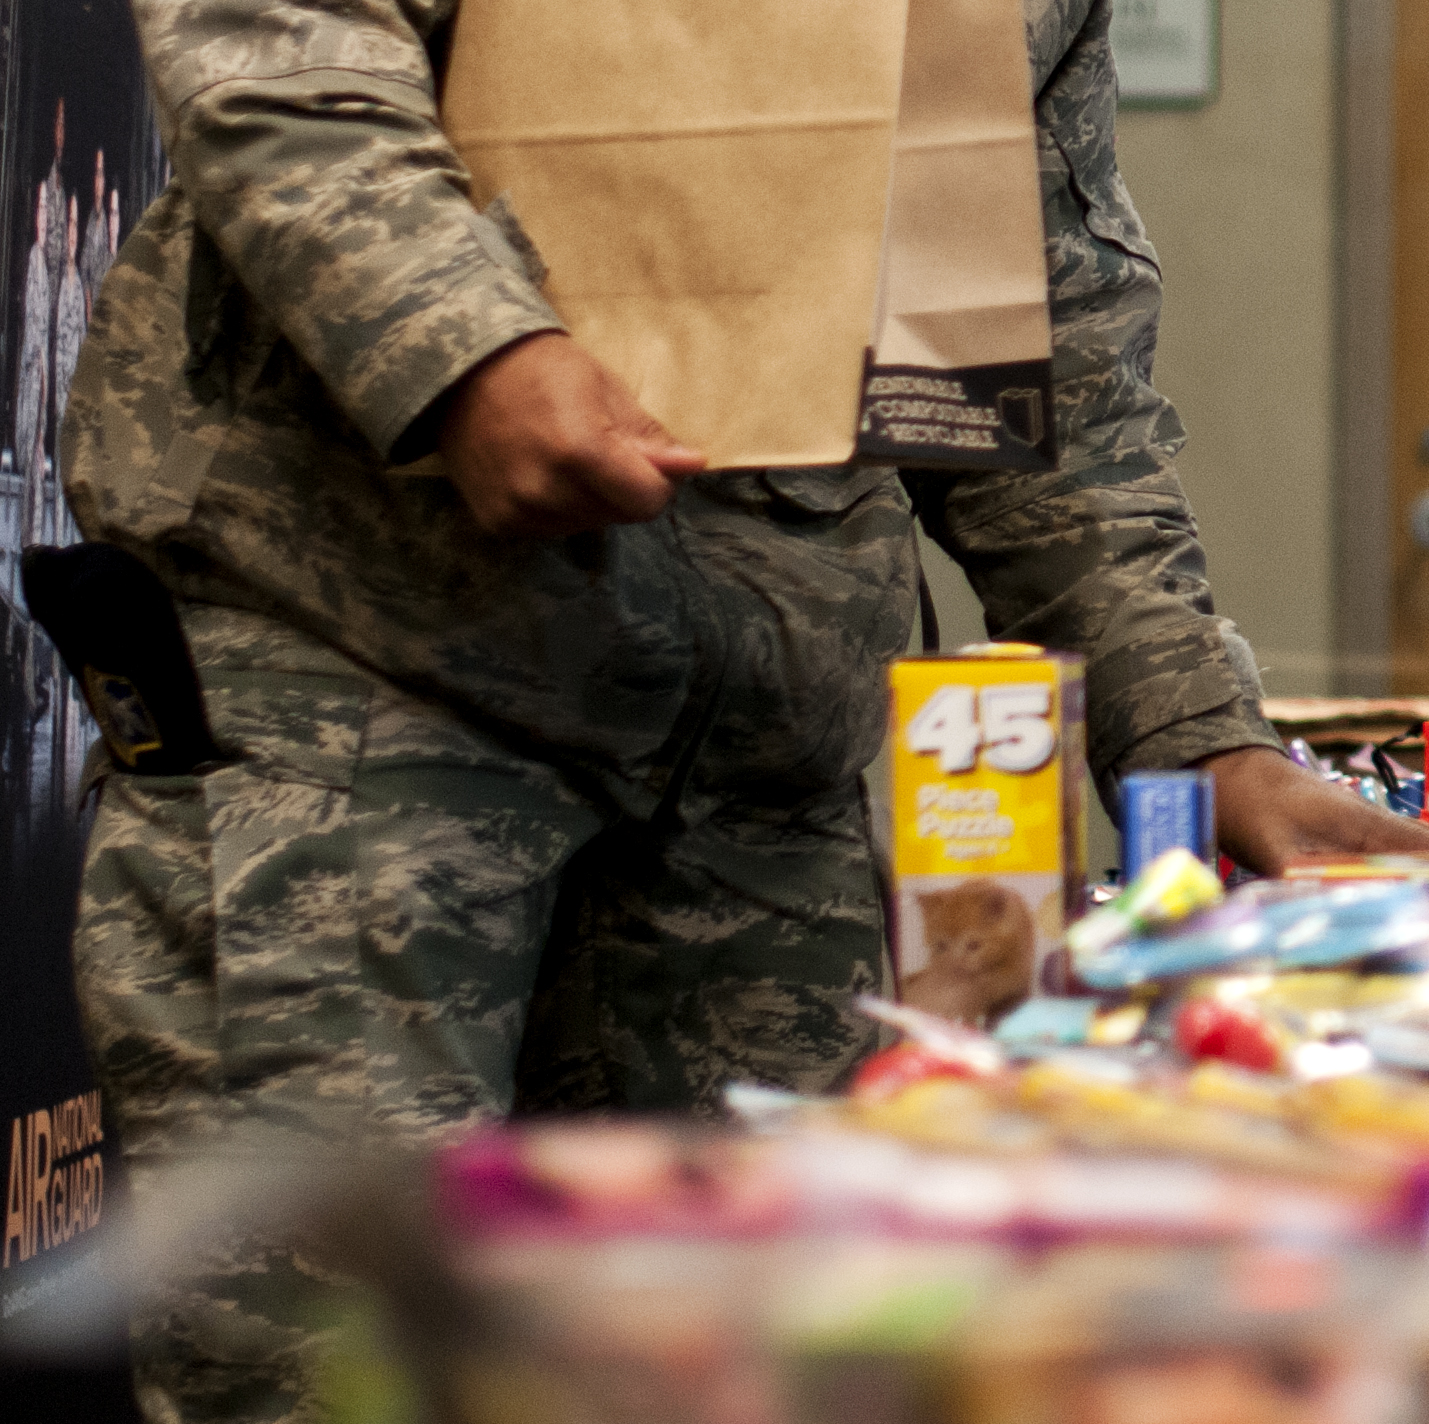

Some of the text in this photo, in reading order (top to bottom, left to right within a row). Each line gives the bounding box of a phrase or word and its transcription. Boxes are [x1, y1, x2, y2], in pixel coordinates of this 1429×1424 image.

[907, 682, 1057, 775] 45
[51, 1089, 104, 1162] NATIONAL
[3, 1109, 51, 1268] AIR
[51, 1152, 104, 1248] GUARD
